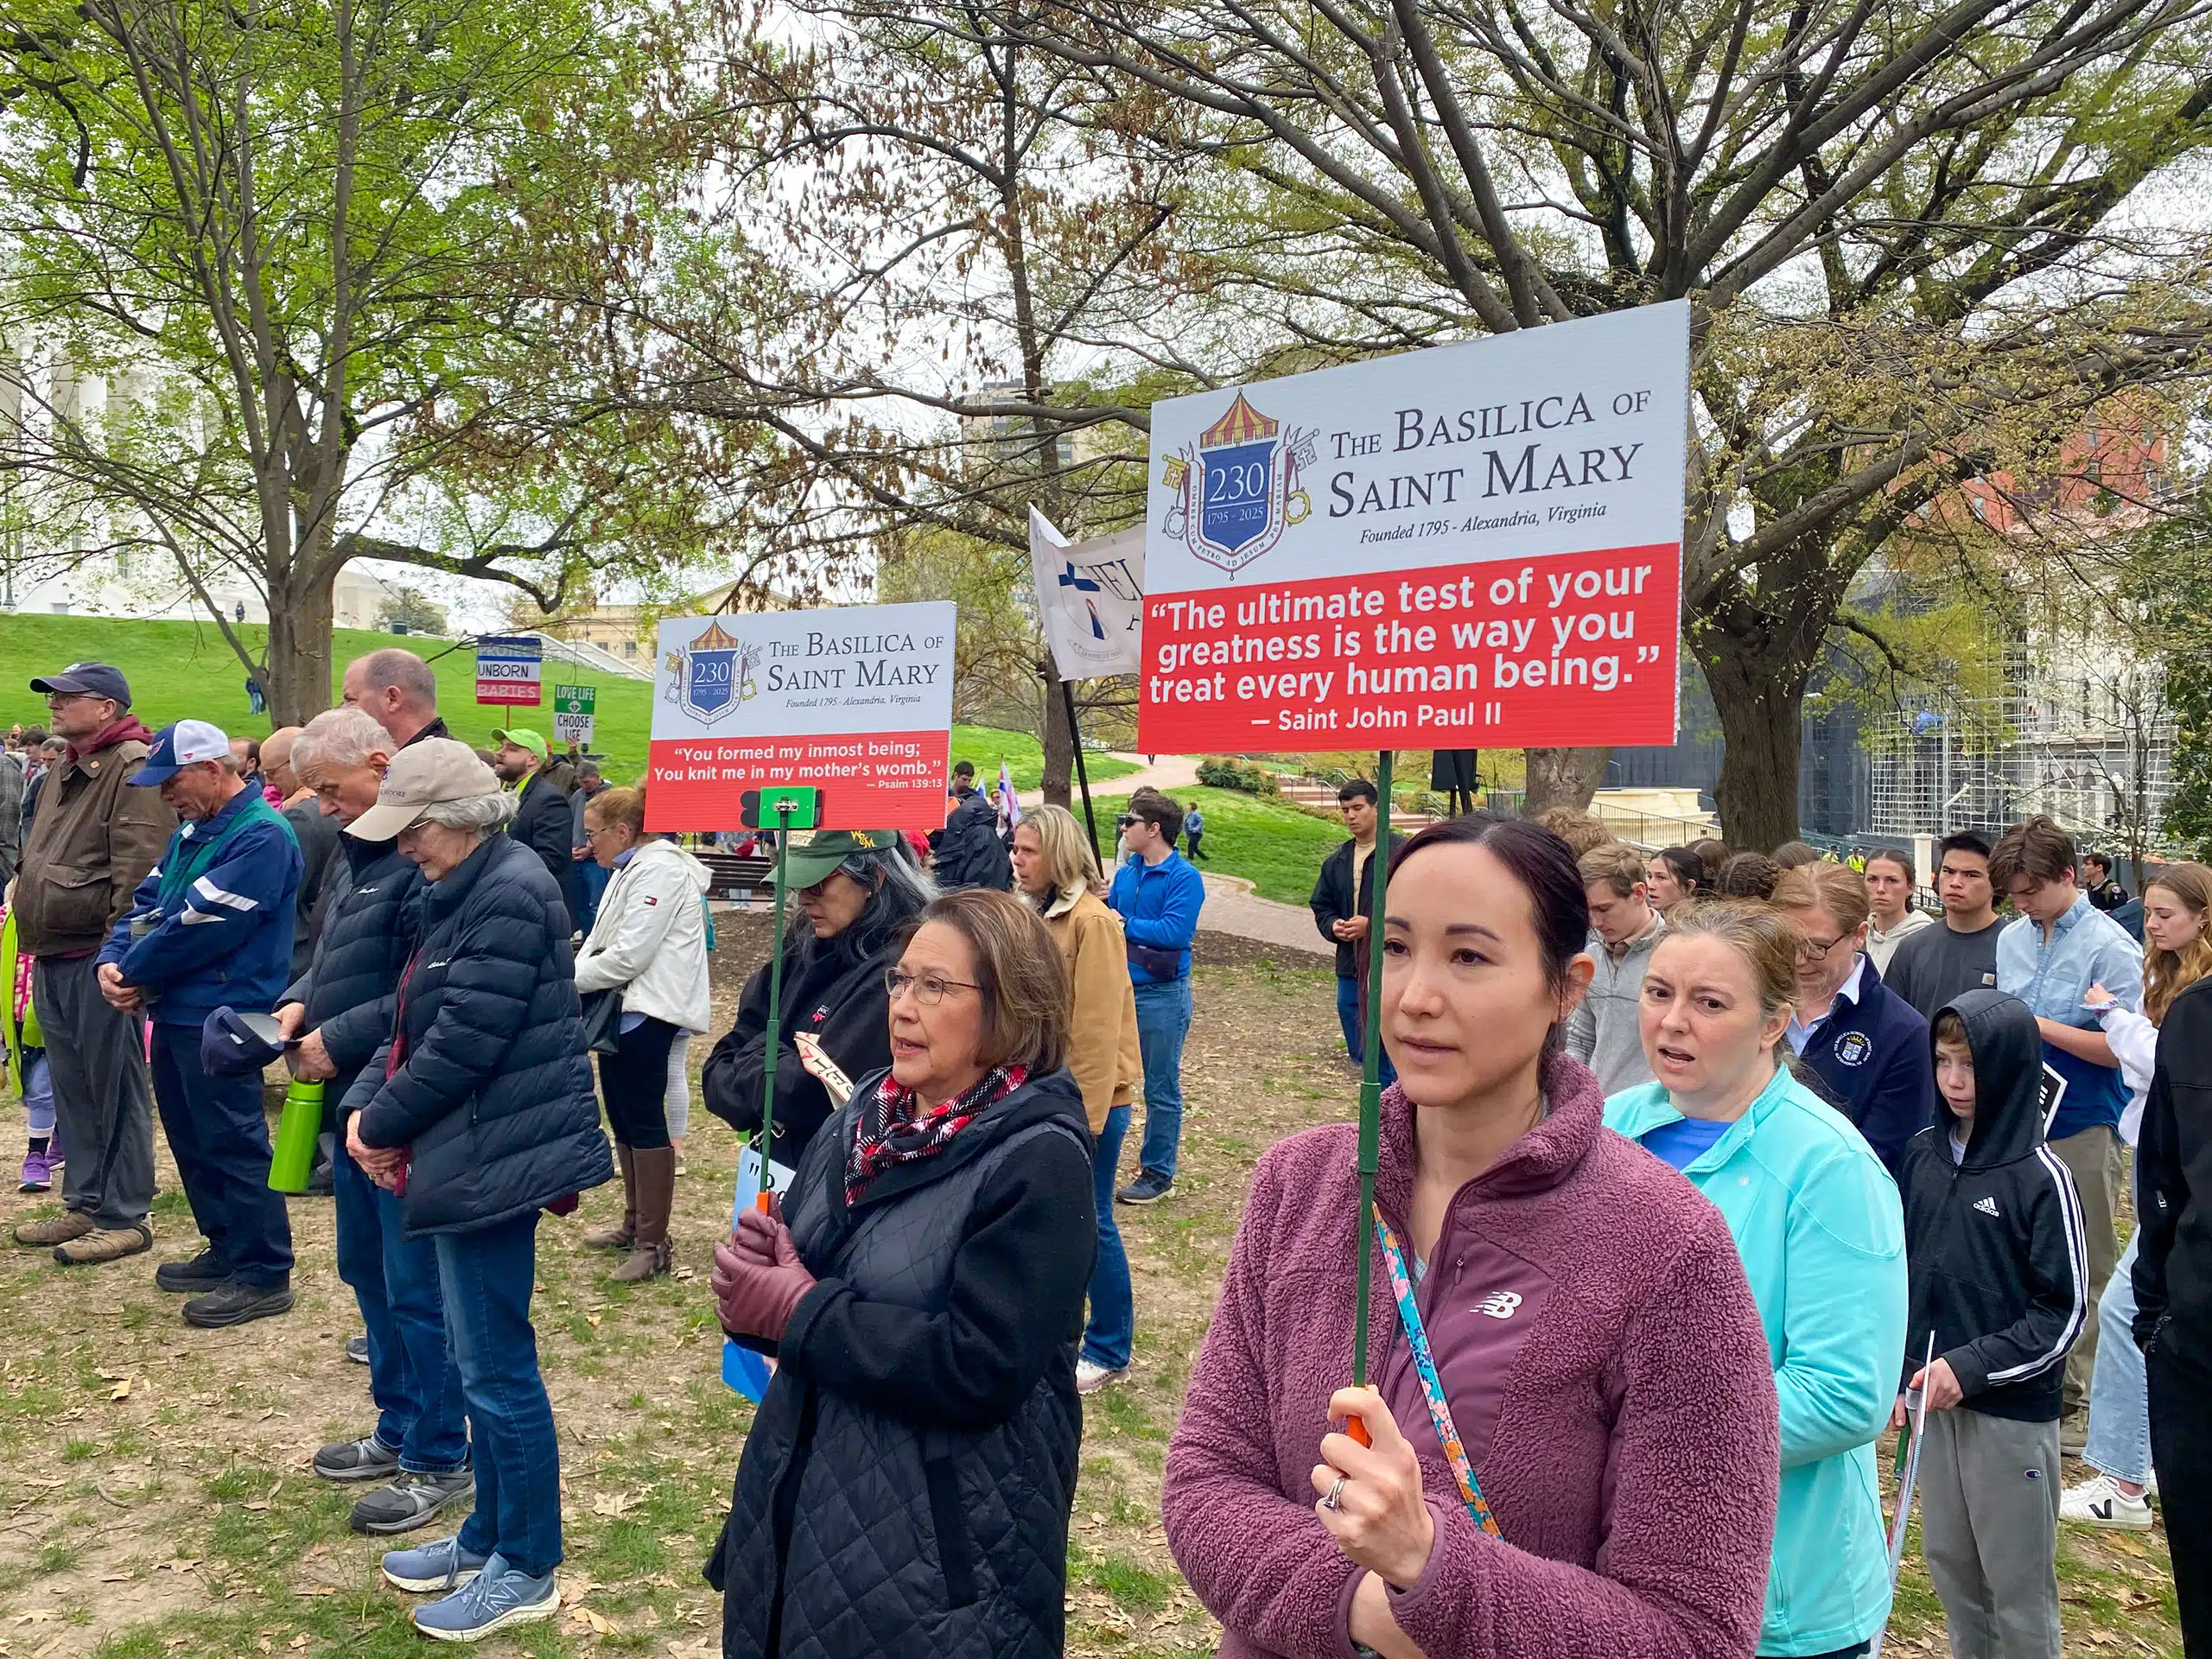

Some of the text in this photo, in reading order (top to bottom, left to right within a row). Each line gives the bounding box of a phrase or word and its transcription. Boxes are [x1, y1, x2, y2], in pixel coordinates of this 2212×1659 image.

[1331, 391, 1650, 459] THE BASILICA OF
[1210, 462, 1264, 503] 230
[1330, 443, 1643, 517] SAINT MARY
[1208, 512, 1229, 525] 1795
[1239, 507, 1263, 521] 2025
[1361, 524, 1414, 543] Founded
[1419, 520, 1449, 537] 1795
[1461, 512, 1539, 531] Alexandria,
[1549, 506, 1606, 523] Virginia
[1152, 600, 1224, 631] “The
[1238, 587, 1384, 626] ultimate
[1399, 576, 1474, 612] test
[1490, 568, 1533, 605] of
[1548, 565, 1651, 607] your
[769, 632, 944, 658] THE BASILICA OF
[1159, 634, 1320, 673] greatness
[1335, 625, 1360, 657] is
[1375, 620, 1436, 653] the
[1452, 619, 1535, 652] way
[1552, 611, 1634, 657] you
[478, 664, 529, 677] UNBORN
[695, 662, 729, 683] 230
[768, 665, 845, 691] SAINT
[855, 660, 939, 687] MARY
[477, 684, 536, 698] BABIES
[693, 688, 707, 696] 1795
[1150, 672, 1225, 702] treat
[1237, 672, 1334, 702] every
[1348, 663, 1477, 694] human
[556, 685, 594, 701] LOVE LIFE
[785, 698, 817, 708] Founded
[819, 697, 837, 707] 1795
[843, 695, 886, 706] Alexandria,
[889, 694, 920, 705] Virginia
[557, 715, 589, 728] CHOOSE
[1279, 709, 1338, 730] Saint
[1346, 706, 1407, 728] John
[1418, 702, 1473, 726] Paul
[1486, 702, 1500, 724] II
[718, 745, 773, 760] formed
[779, 747, 803, 760] my
[809, 743, 863, 757] inmost
[869, 741, 919, 757] being;
[655, 768, 683, 780] You
[689, 766, 716, 779] knit
[722, 769, 745, 779] me
[752, 765, 764, 779] in
[771, 767, 793, 780] my
[912, 779, 942, 788] 139:13
[1973, 1202, 1999, 1217] adidas
